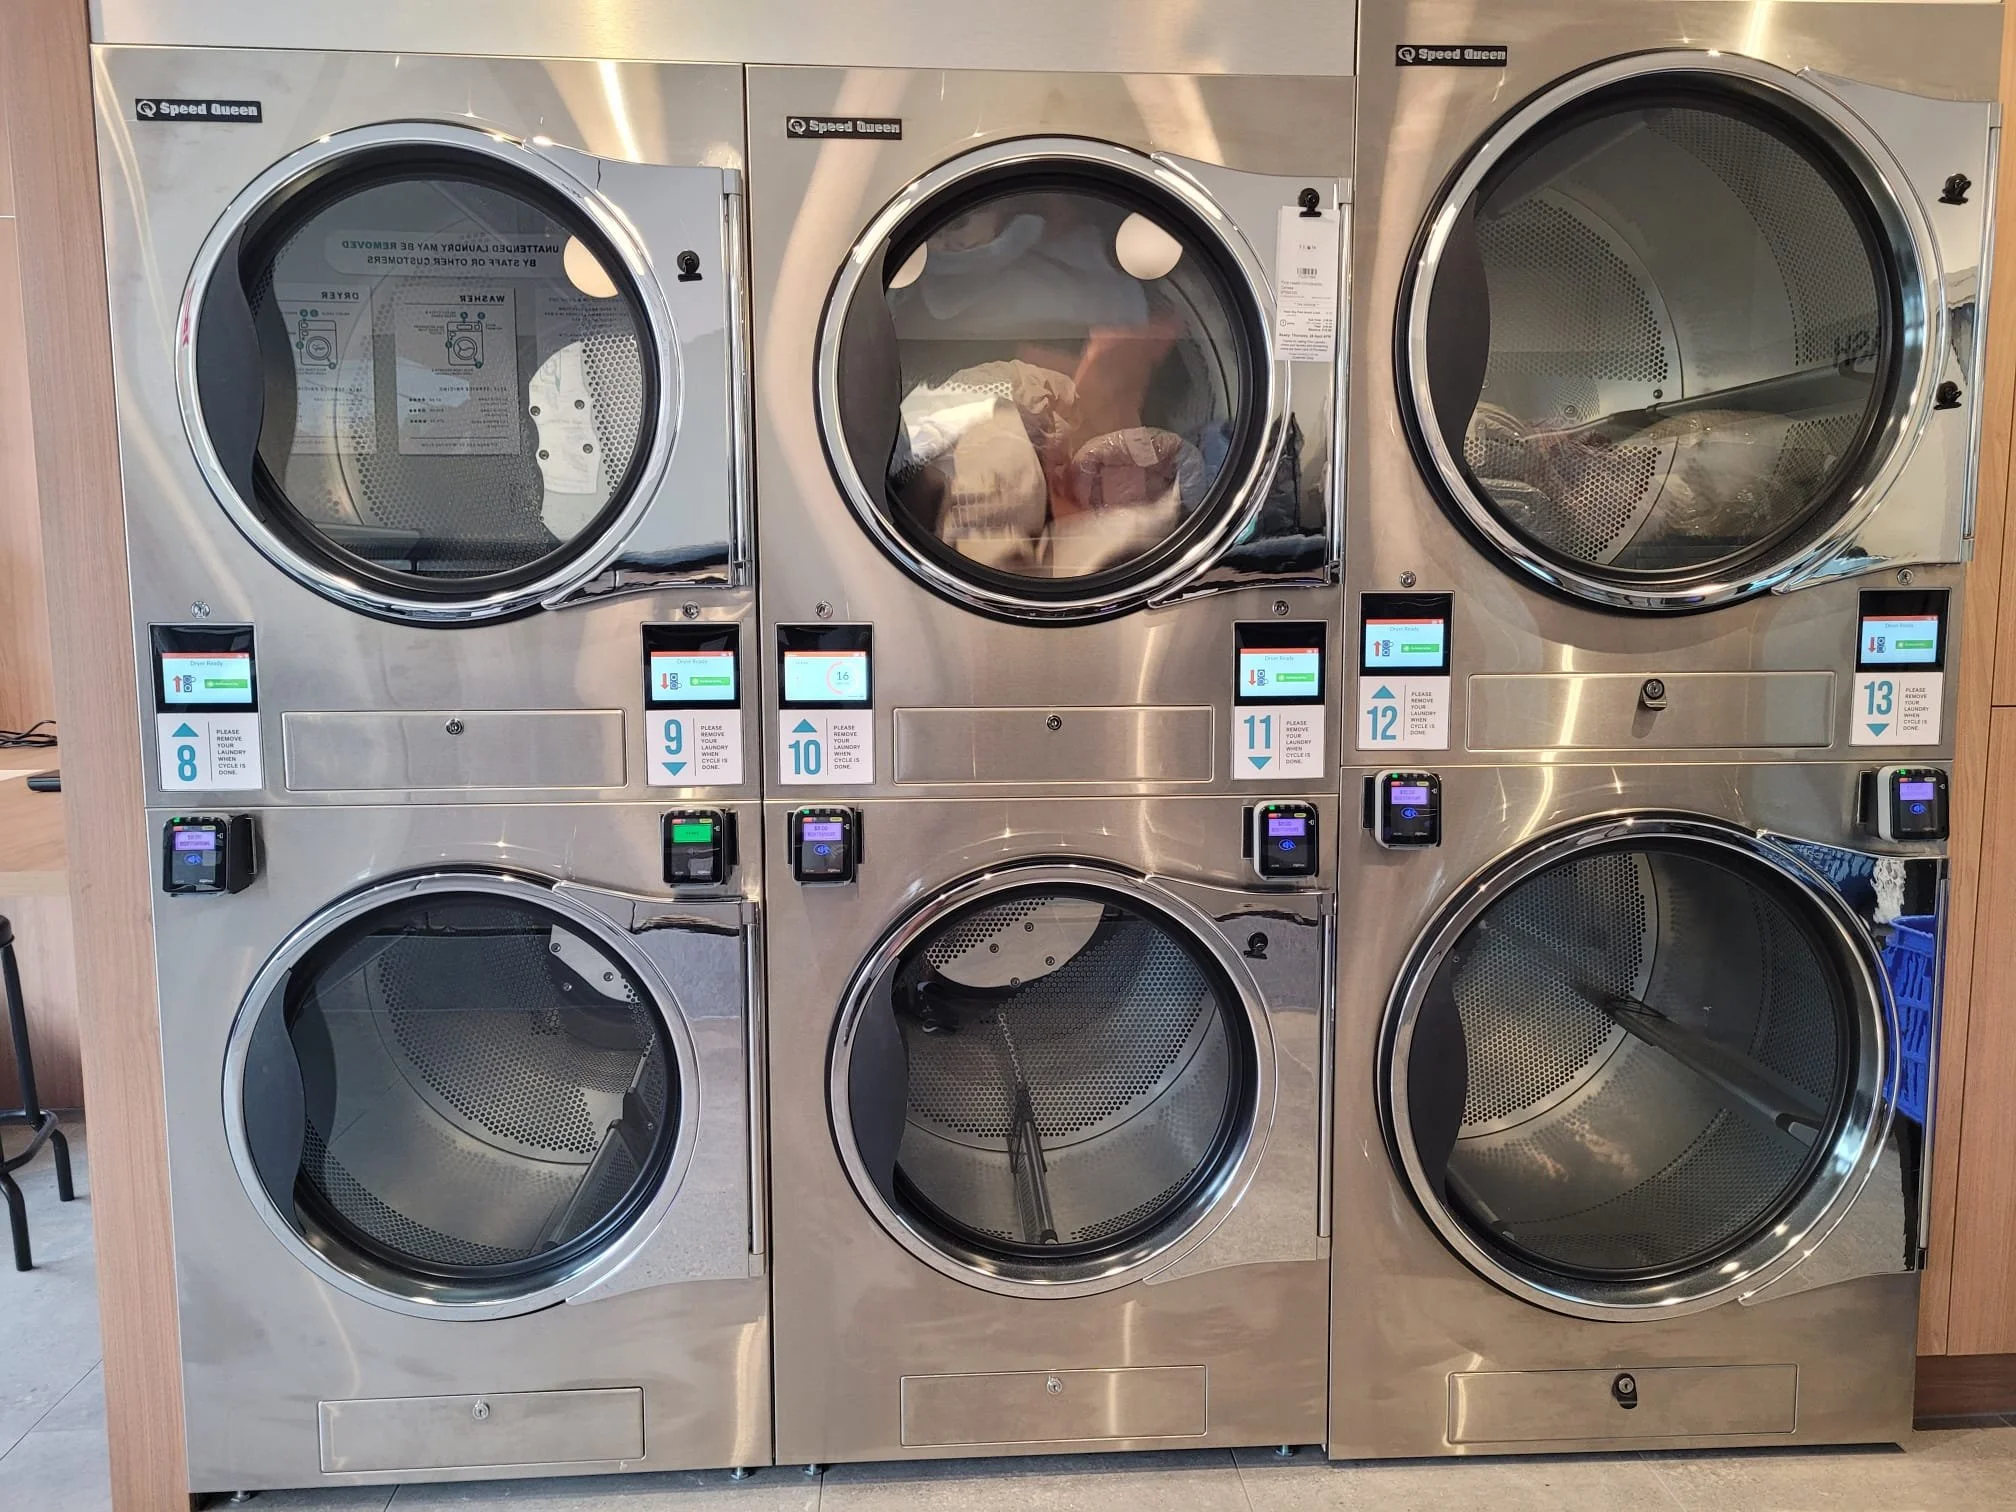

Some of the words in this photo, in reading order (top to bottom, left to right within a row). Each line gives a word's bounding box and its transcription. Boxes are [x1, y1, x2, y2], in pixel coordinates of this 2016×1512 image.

[1418, 48, 1460, 61] Speed
[1464, 49, 1506, 60] Queen
[160, 102, 207, 116] Speed
[211, 104, 258, 116] Queen
[809, 120, 852, 134] Speed
[856, 121, 900, 133] Queen
[836, 672, 850, 680] 16
[1864, 680, 1893, 716] 13
[664, 719, 682, 755] 9
[1244, 715, 1272, 750] 11
[1366, 705, 1398, 740] 12
[177, 744, 198, 782] 8
[788, 740, 821, 774] 10
